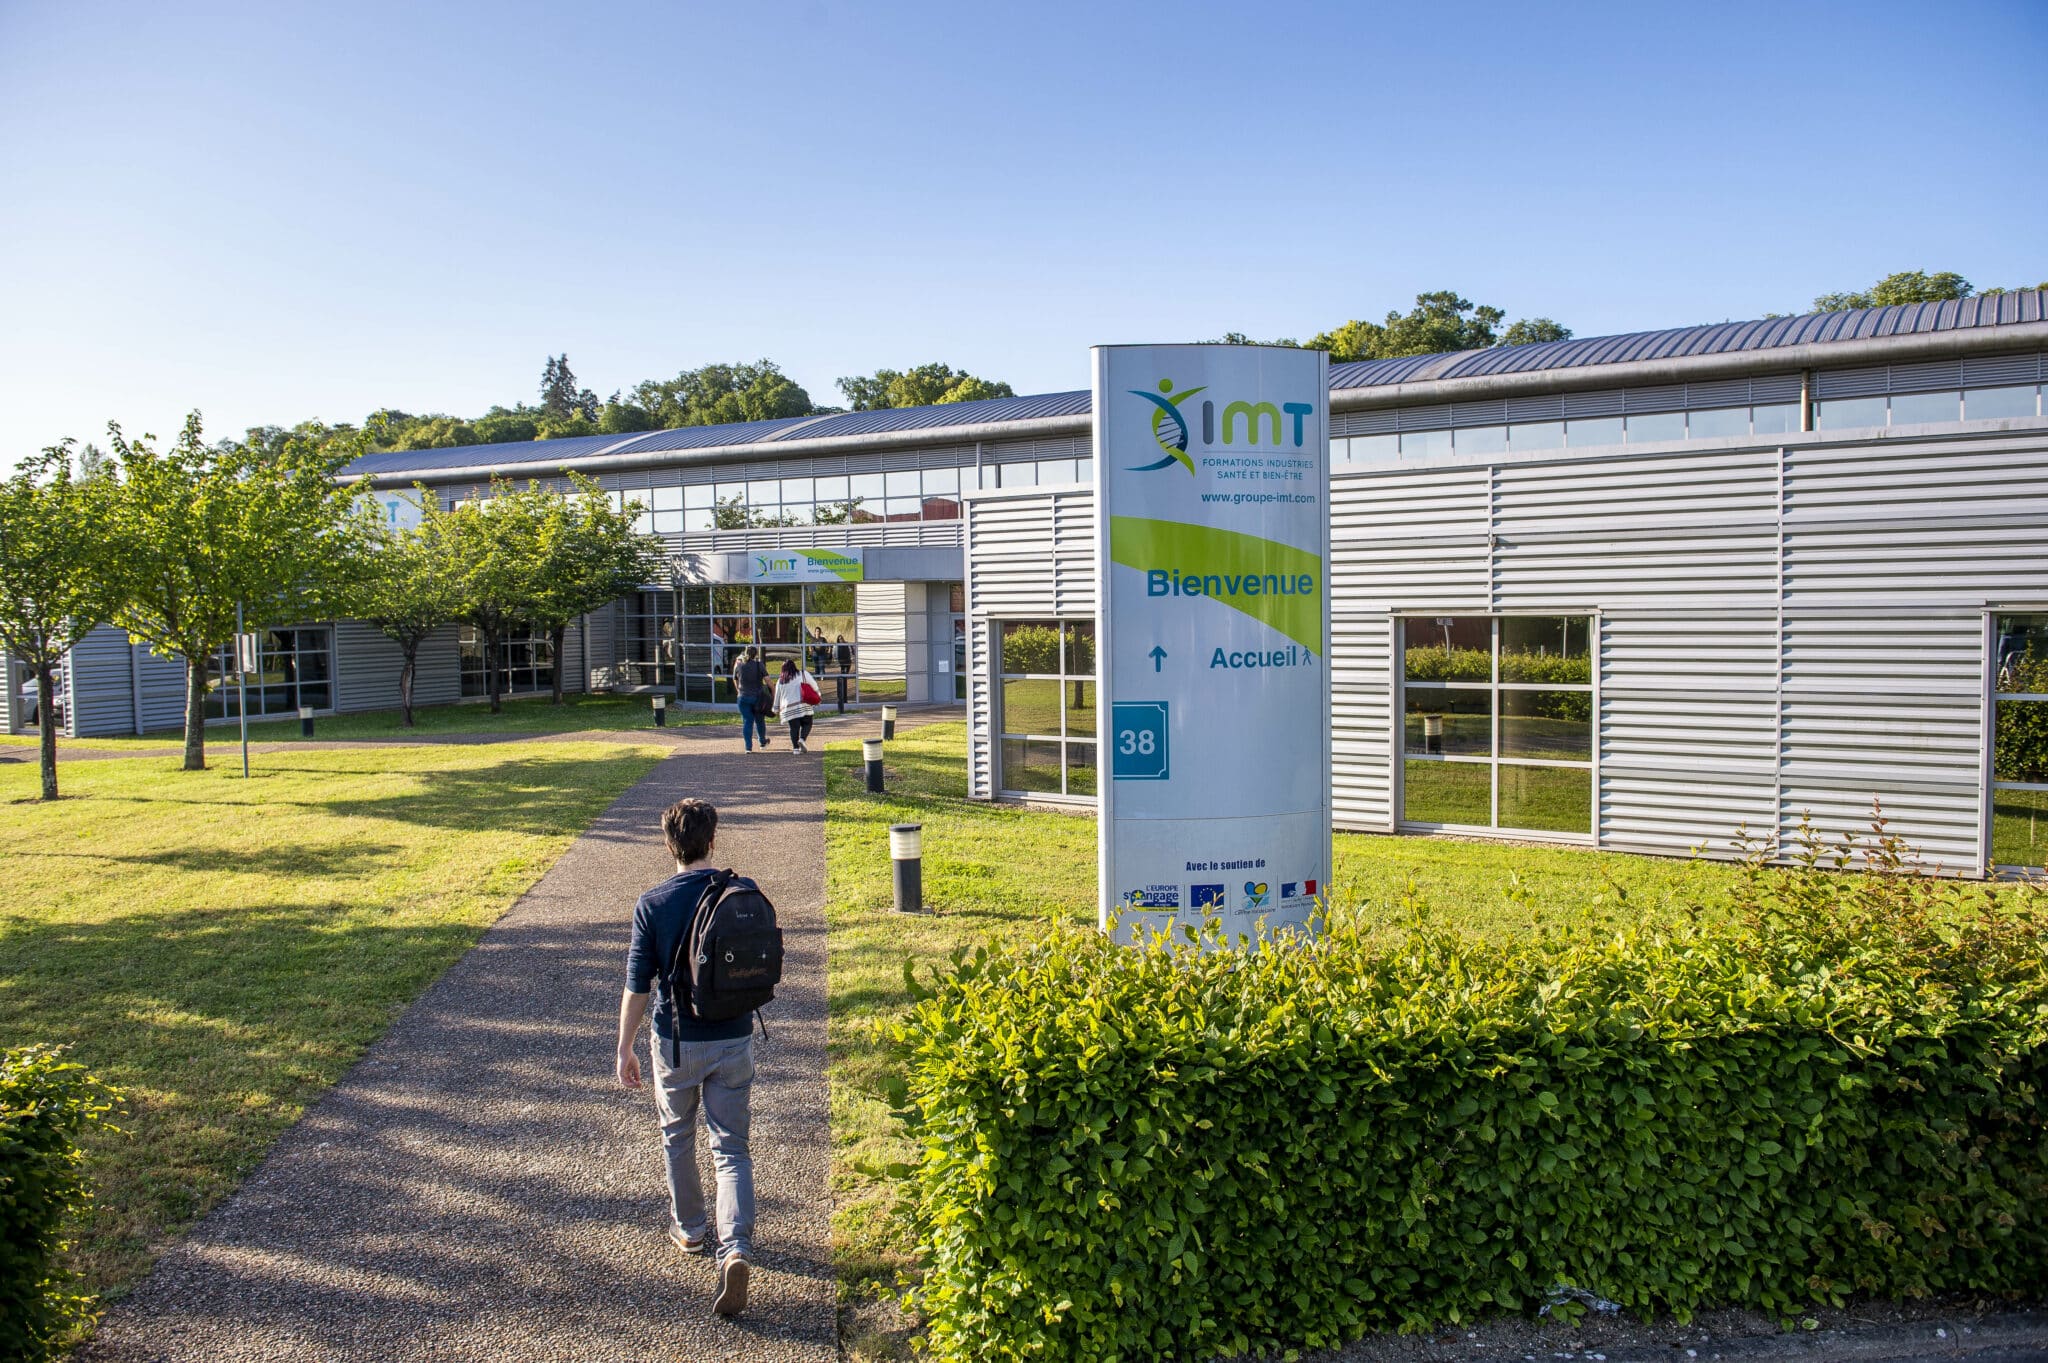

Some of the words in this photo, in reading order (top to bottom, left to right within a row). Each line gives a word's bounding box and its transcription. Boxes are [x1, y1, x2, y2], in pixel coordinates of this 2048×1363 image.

[1202, 458, 1264, 467] FORMATIONS
[1266, 459, 1314, 469] INDUSTRIES
[1217, 469, 1247, 479] SANTÉ
[1249, 471, 1260, 479] ET
[1262, 470, 1303, 481] BIEN-ÊTRE
[1201, 492, 1316, 504] www.groupe-imt.com
[807, 556, 858, 566] Bienvenue
[1147, 569, 1313, 597] Bienvenue
[1209, 646, 1297, 669] Accueil
[1119, 729, 1155, 755] 38
[1186, 861, 1208, 871] Avec
[1209, 861, 1219, 871] le
[1220, 860, 1254, 870] soutien
[1255, 858, 1266, 868] de
[1146, 884, 1178, 892] L'EUROPE
